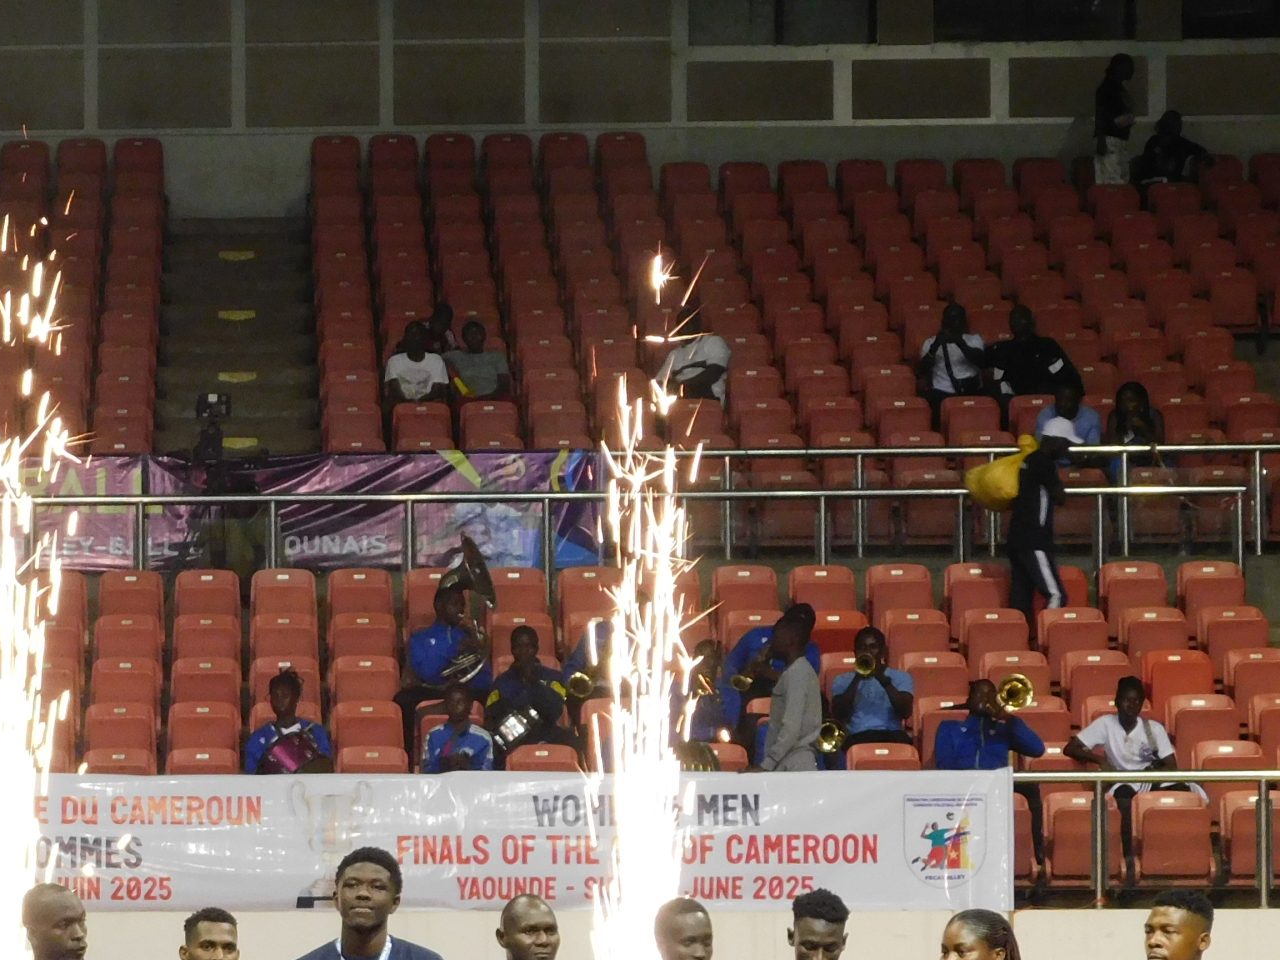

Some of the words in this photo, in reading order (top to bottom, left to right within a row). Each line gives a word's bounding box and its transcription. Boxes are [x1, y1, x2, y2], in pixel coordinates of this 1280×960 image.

[61, 796, 98, 825] DU
[110, 796, 262, 825] CAMEROUN
[697, 794, 760, 826] MEN
[24, 836, 143, 869] OMMES
[396, 834, 490, 865] FINALS
[501, 834, 536, 865] OF
[546, 834, 600, 864] THE
[681, 834, 714, 864] OF
[726, 833, 878, 864] CAMEROON
[110, 876, 172, 900] 2025
[457, 876, 556, 901] YAOUNDE
[684, 876, 743, 900] JUNE
[753, 875, 814, 900] 2025
